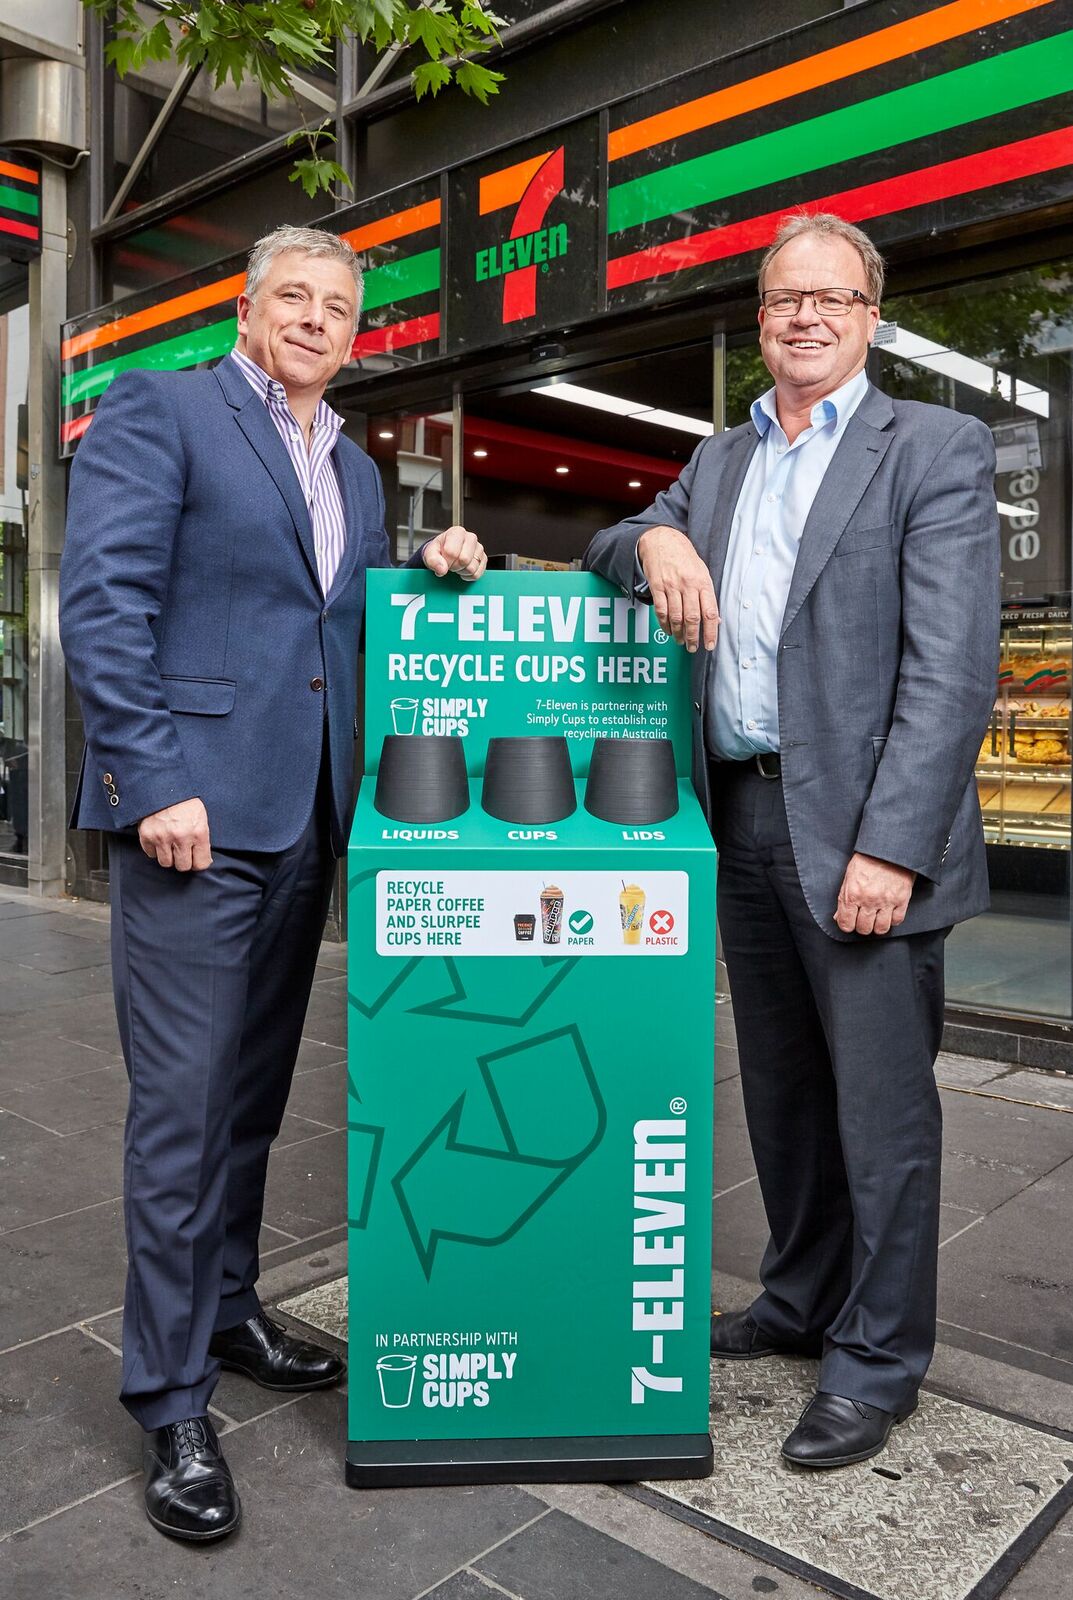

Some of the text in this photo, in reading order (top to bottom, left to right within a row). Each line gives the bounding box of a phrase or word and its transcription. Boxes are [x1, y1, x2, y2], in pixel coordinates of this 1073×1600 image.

[479, 145, 565, 325] 7
[515, 655, 585, 683] CUPS
[597, 657, 668, 684] HERE
[422, 697, 489, 718] SIMPLY
[535, 699, 668, 714] 7-Eleven is partnering with
[526, 712, 668, 727] Simply Cups to establish cup
[422, 717, 470, 738] CUPS
[563, 727, 668, 741] recycling in Australia
[381, 829, 460, 842] LIQUIDS
[507, 830, 559, 841] CUPS
[622, 830, 667, 841] LIDS
[386, 897, 486, 912] PAPER COFFEE
[386, 914, 482, 930] AND SLURPEE
[386, 931, 463, 946] CUPS HERE
[567, 937, 595, 946] PAPER
[645, 936, 679, 946] PLASTIC
[375, 1332, 518, 1347] IN PARTNERSHIP WITH
[422, 1352, 517, 1380] SIMPLY
[422, 1380, 490, 1408] CUPS
